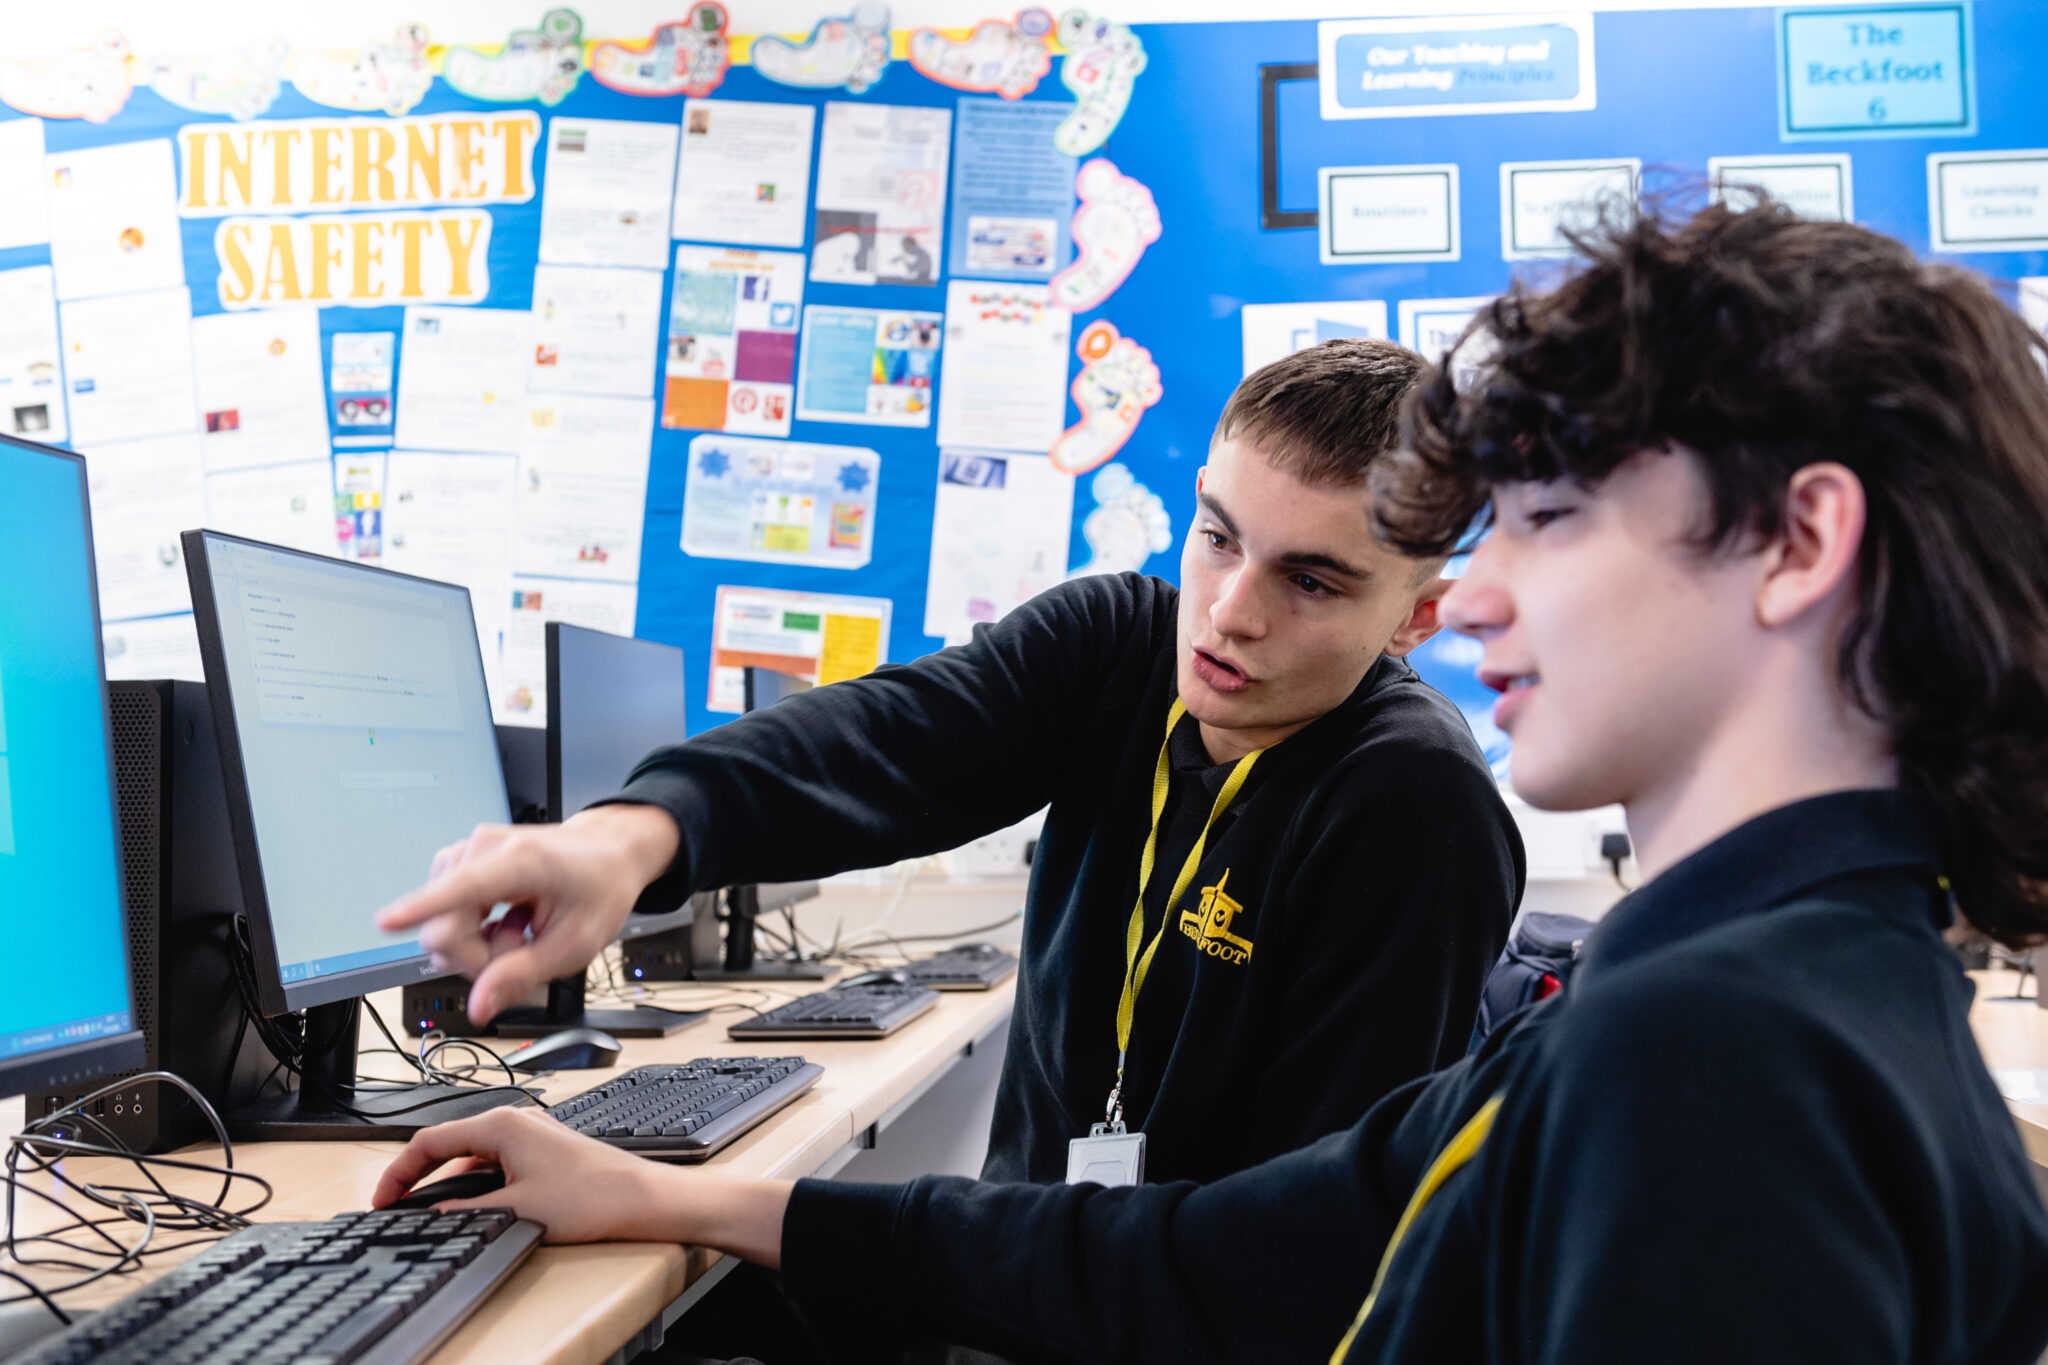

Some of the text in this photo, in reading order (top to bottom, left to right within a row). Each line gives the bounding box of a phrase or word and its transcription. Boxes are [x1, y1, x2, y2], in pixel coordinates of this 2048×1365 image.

[1846, 23, 1903, 46] The
[1366, 40, 1550, 67] Our Teaching and
[1361, 64, 1555, 91] Learning Principles
[1807, 58, 1943, 86] Beckfoot
[1868, 97, 1887, 122] 6
[185, 119, 535, 207] INTERNET
[224, 218, 482, 302] SAFETY
[1183, 923, 1247, 964] BFOOT
